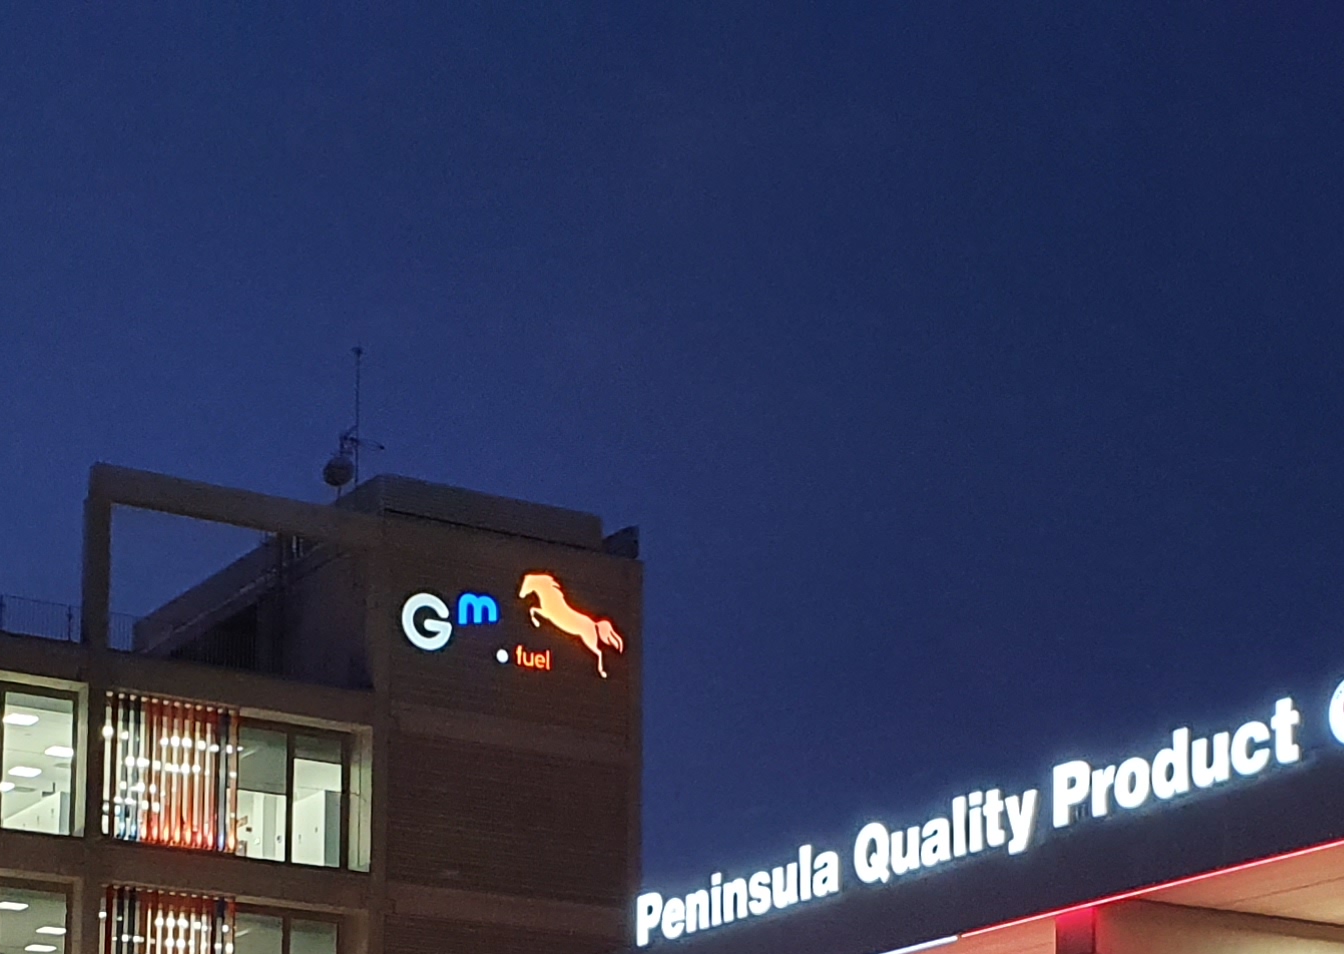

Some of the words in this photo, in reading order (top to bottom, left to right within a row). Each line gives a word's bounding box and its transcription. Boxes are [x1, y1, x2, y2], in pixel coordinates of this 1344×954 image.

[516, 645, 551, 670] fuel
[636, 845, 839, 946] Peninsula
[856, 786, 1038, 883] Quality
[1053, 697, 1301, 828] Product
